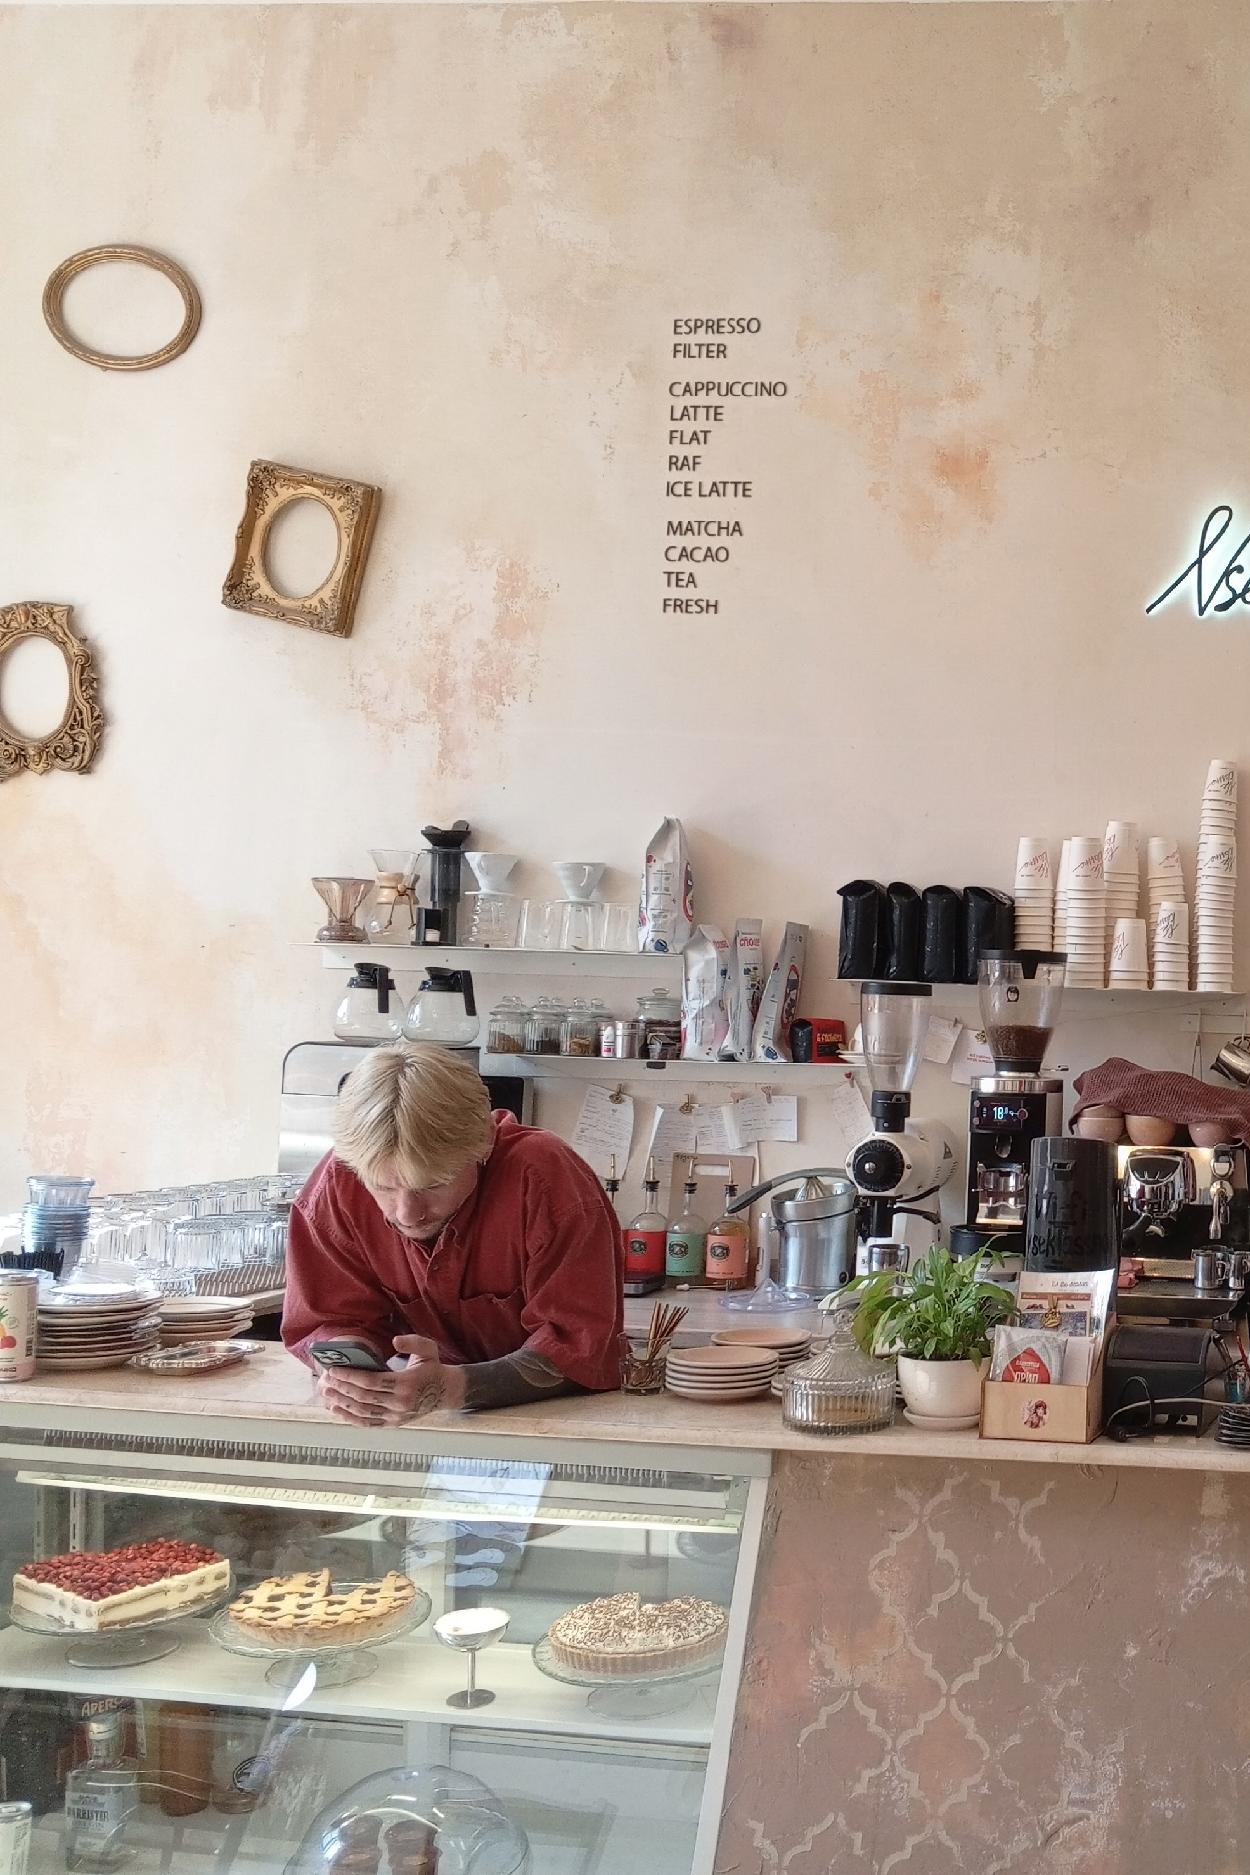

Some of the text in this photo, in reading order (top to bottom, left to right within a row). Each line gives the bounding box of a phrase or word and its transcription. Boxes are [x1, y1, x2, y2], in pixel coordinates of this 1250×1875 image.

[672, 317, 761, 335] ESPRESSO
[672, 343, 727, 359] FILTER
[668, 381, 788, 397] CAPPUCCINO
[670, 405, 725, 422] LATTE
[668, 430, 712, 445] FLAT
[668, 455, 702, 472] RAF
[666, 481, 753, 498] ICE LATTE
[666, 520, 743, 537] MATCHA
[664, 546, 730, 563] CACAO
[663, 571, 698, 588] TEA
[662, 598, 719, 615] FRESH
